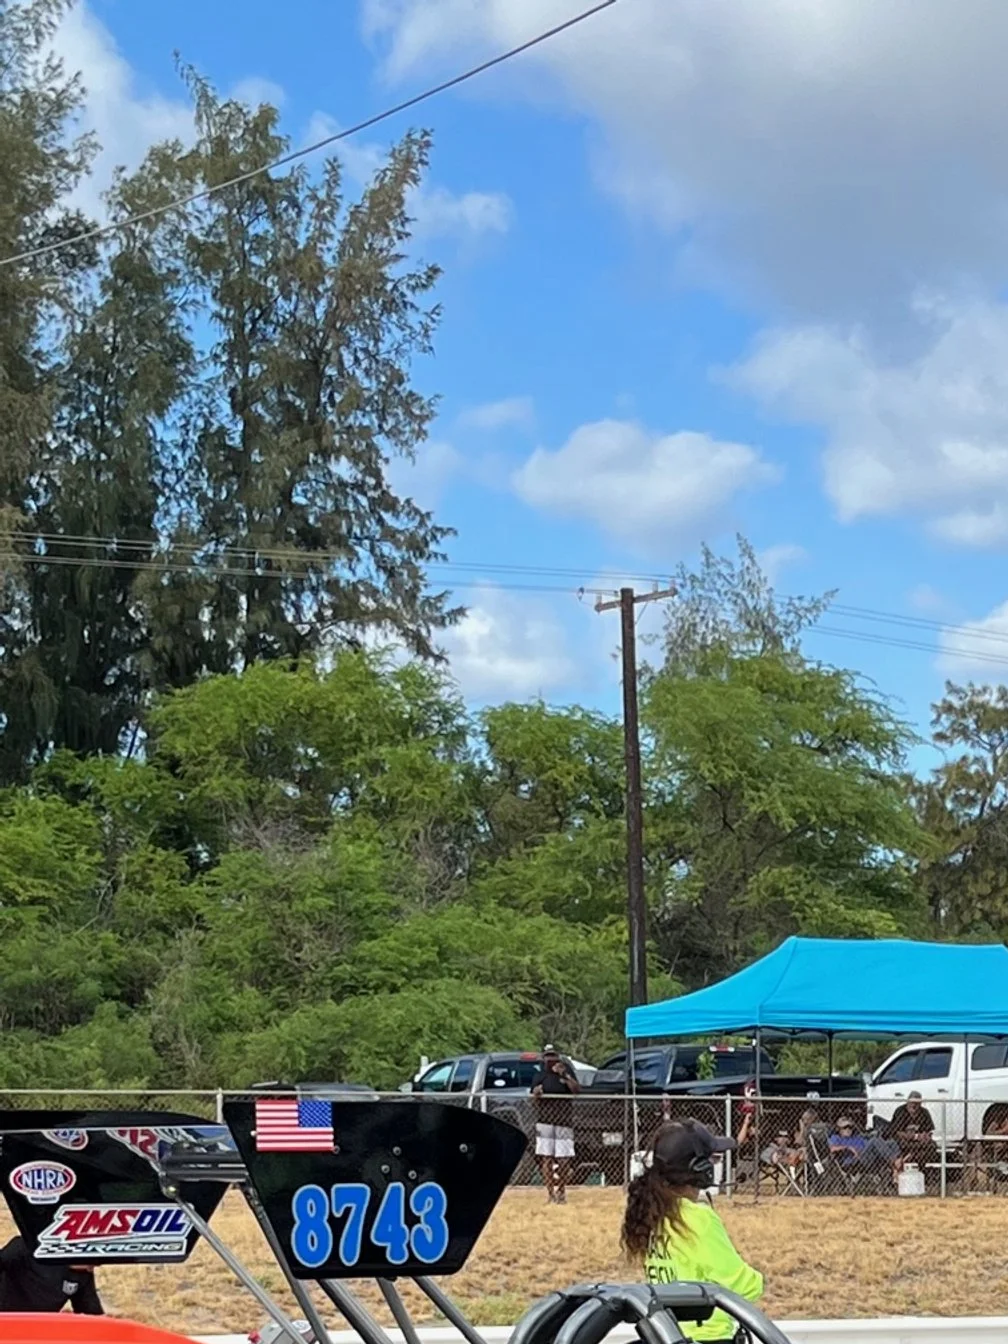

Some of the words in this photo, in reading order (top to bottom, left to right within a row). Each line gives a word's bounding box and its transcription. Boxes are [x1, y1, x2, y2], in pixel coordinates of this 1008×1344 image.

[22, 1169, 65, 1190] NHRA
[51, 1209, 188, 1240] AMSOIL
[291, 1181, 449, 1267] 8743
[85, 1243, 182, 1254] RACING
